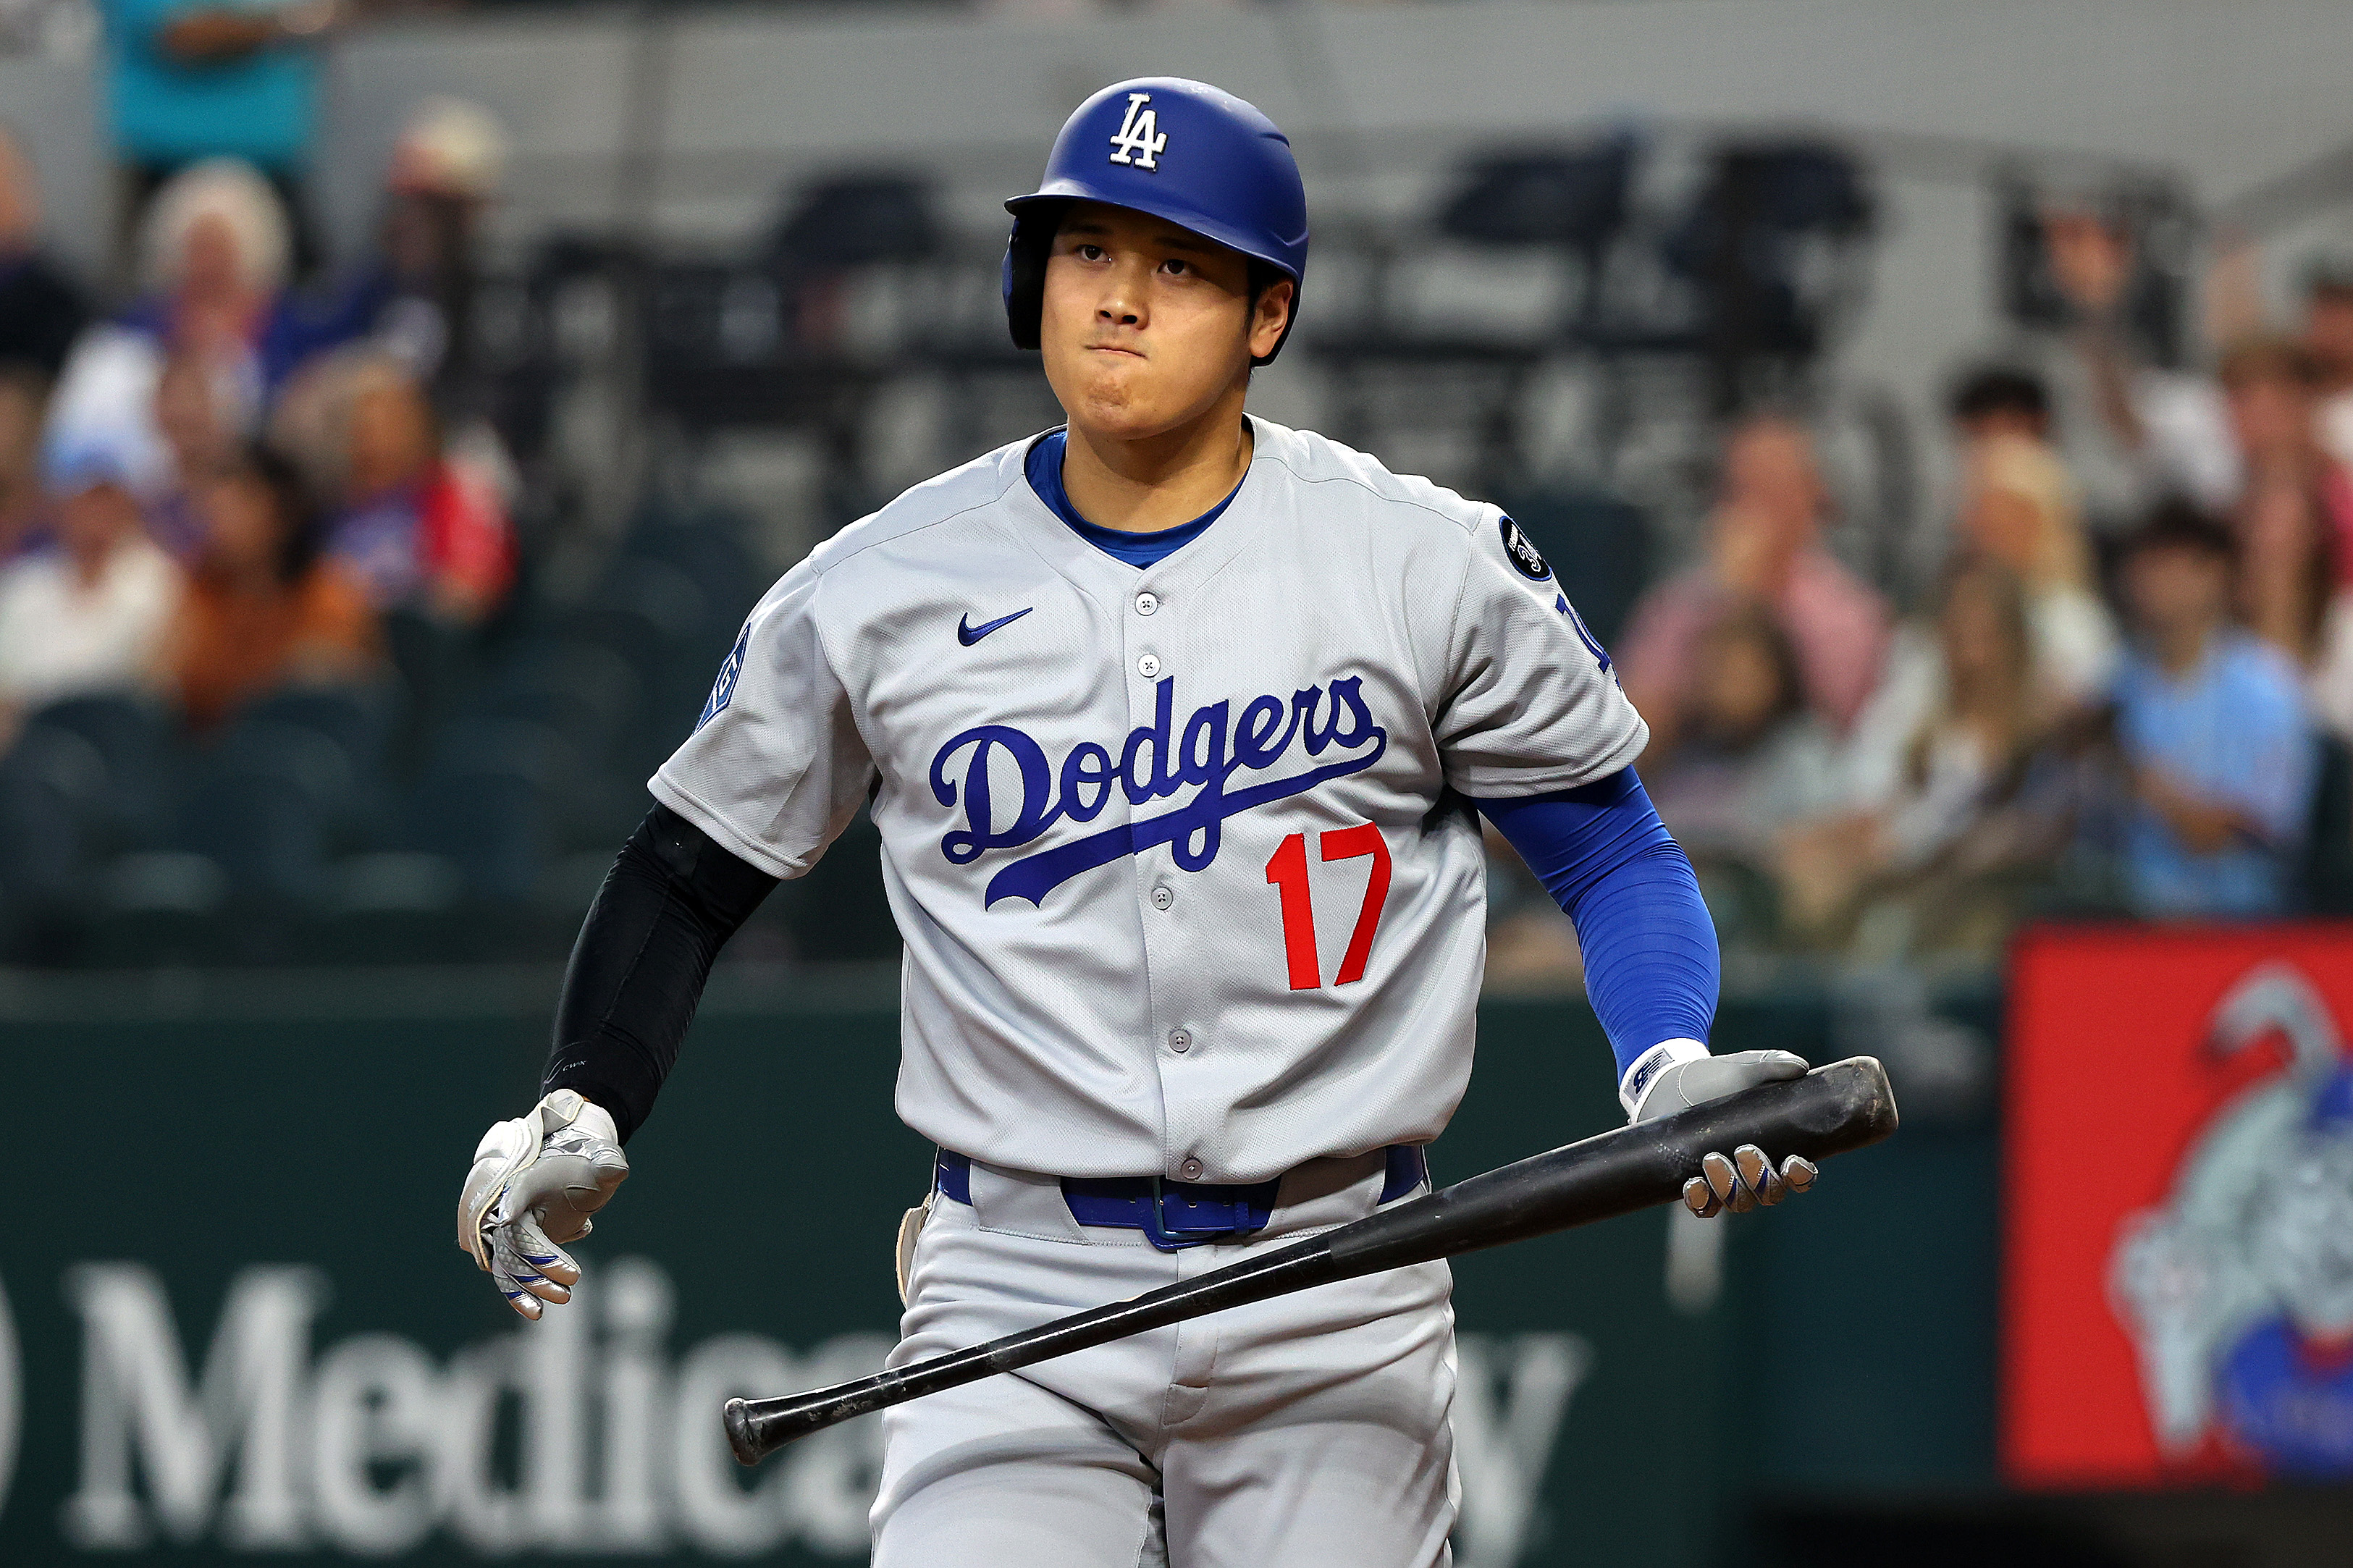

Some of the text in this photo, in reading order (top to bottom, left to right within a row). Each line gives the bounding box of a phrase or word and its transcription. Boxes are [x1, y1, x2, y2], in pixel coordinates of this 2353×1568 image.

[1109, 93, 1168, 172] LA
[930, 675, 1387, 873] Dodgers
[1266, 822, 1392, 991] 17
[65, 1258, 887, 1551] Medica
